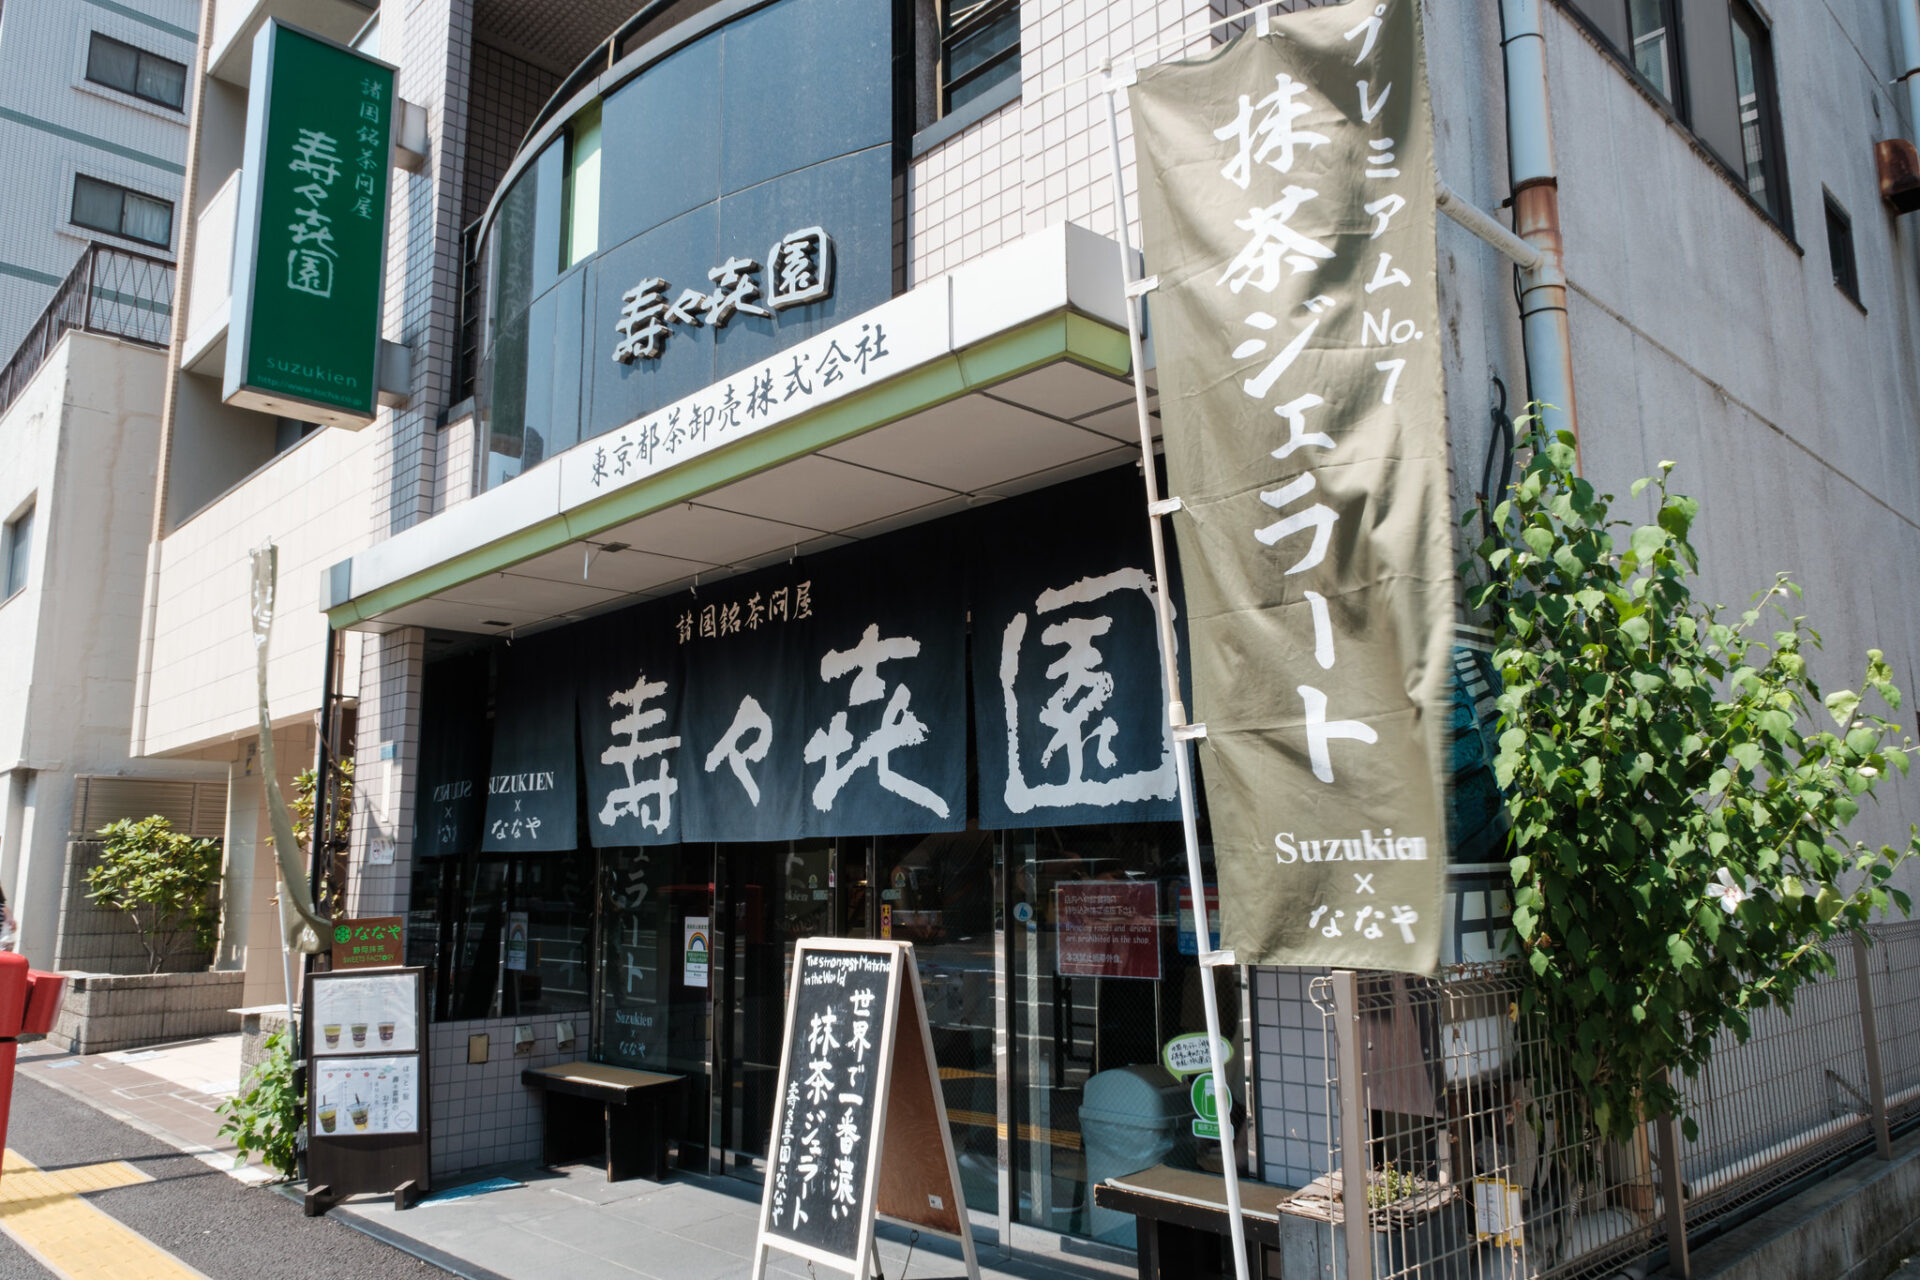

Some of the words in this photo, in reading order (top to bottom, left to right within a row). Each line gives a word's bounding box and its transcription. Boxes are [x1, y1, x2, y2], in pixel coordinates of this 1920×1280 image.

[266, 357, 358, 389] suzukien
[590, 323, 889, 487] 東京都茶卸売株式会社
[1213, 73, 1378, 783] 抹茶ジェラート
[491, 817, 541, 840] ななや
[354, 925, 401, 941] ななや
[1309, 905, 1418, 944] ななや
[804, 971, 811, 985] in
[859, 955, 892, 972] Matcha
[792, 1005, 840, 1231] 抹茶ジェラート
[830, 988, 875, 1220] 世界で一番濃い
